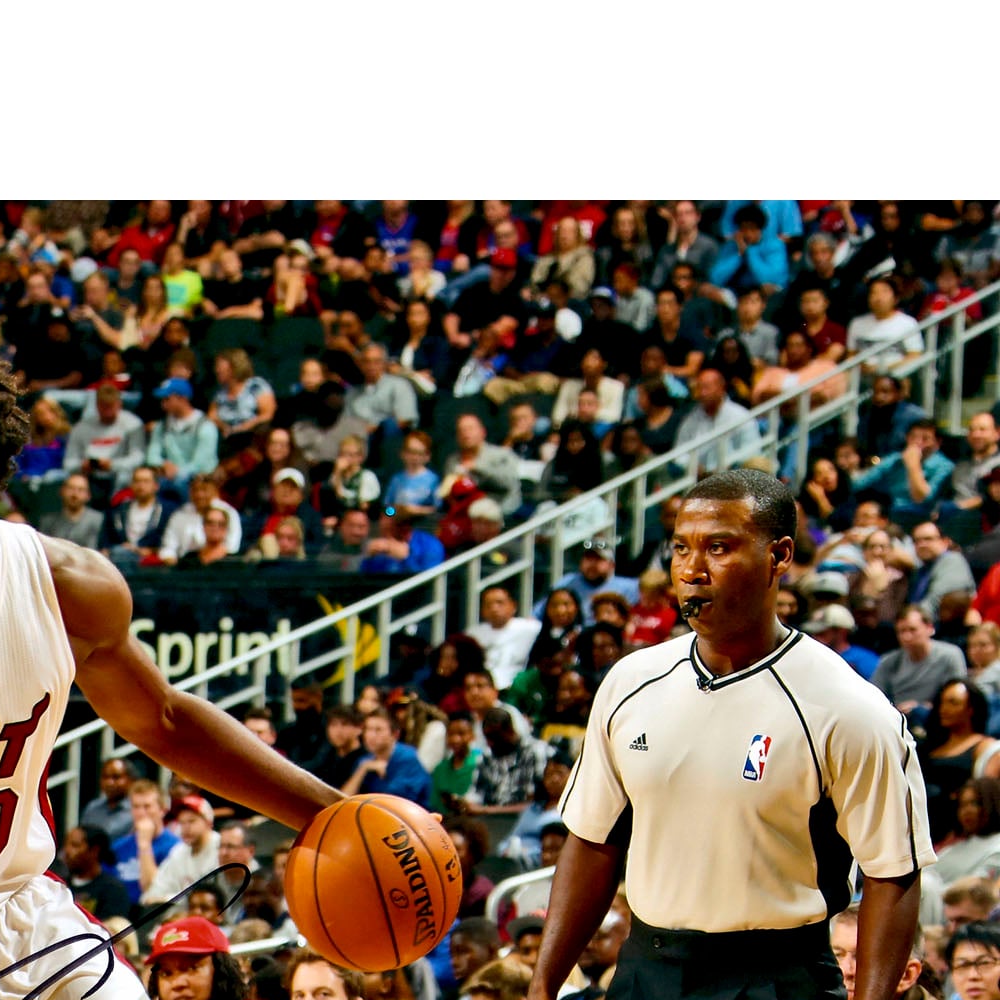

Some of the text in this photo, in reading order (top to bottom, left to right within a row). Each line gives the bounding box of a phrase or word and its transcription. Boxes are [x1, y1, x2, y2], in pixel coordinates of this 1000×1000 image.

[128, 616, 291, 683] Sprint
[629, 743, 649, 751] adidas
[382, 824, 436, 946] SPALDING
